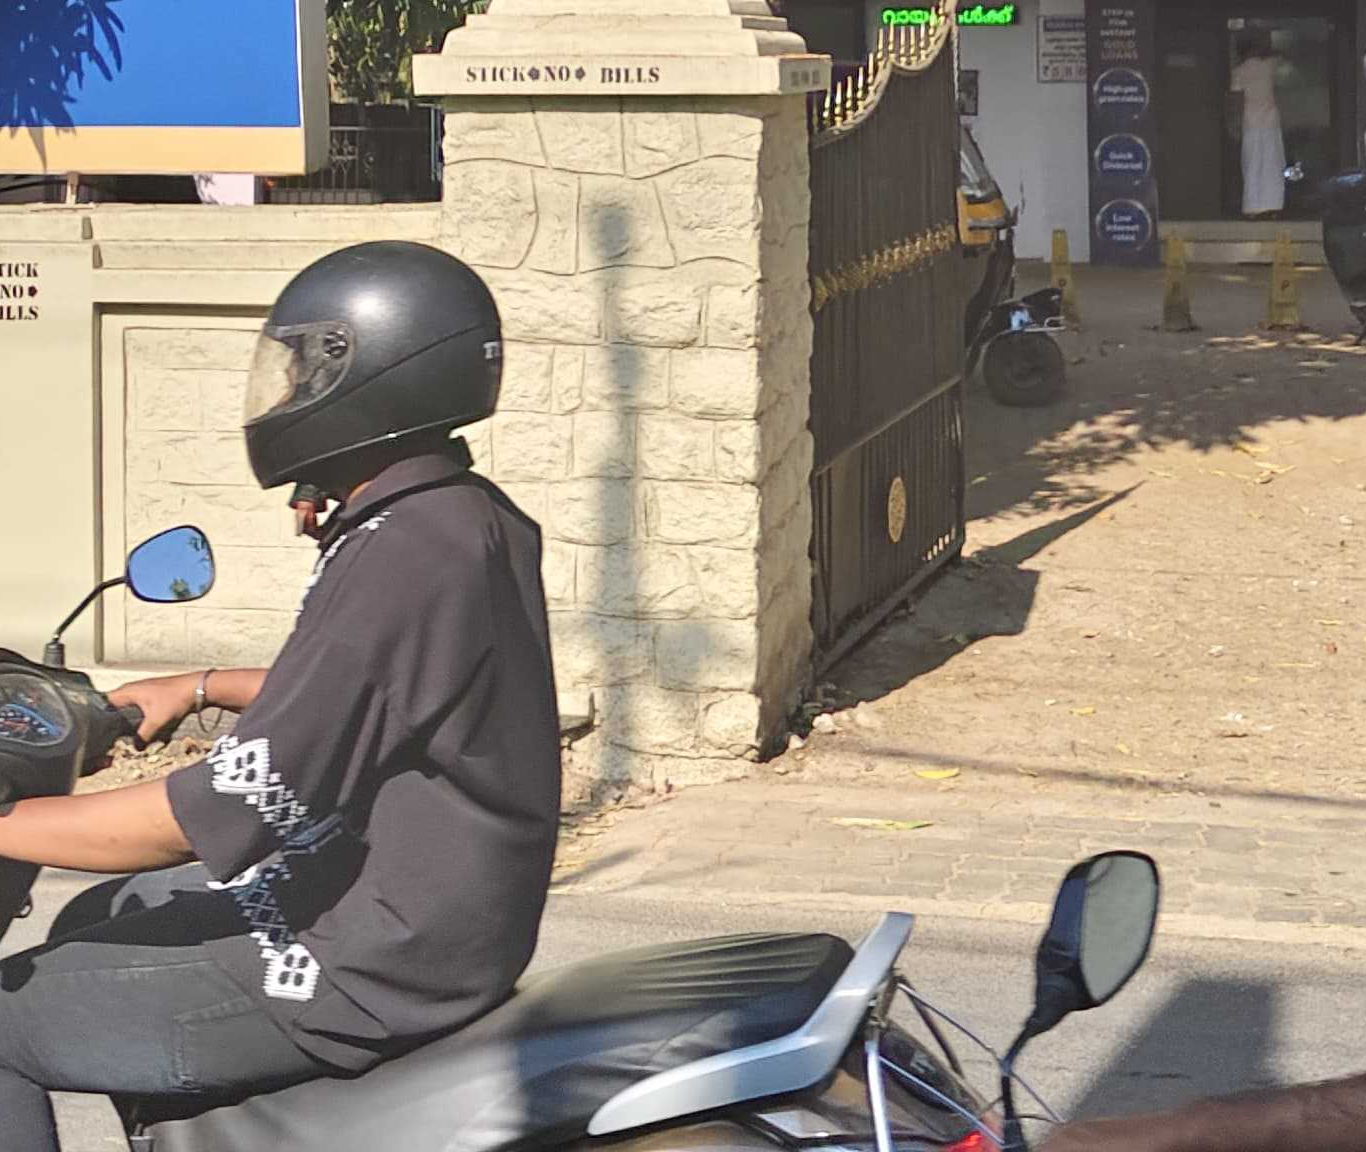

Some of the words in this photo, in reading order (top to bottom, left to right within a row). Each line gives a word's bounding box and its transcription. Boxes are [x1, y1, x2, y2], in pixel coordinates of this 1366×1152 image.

[466, 66, 526, 83] STICK
[544, 65, 571, 82] NO
[600, 66, 660, 84] BILLS
[0, 283, 24, 299] NO
